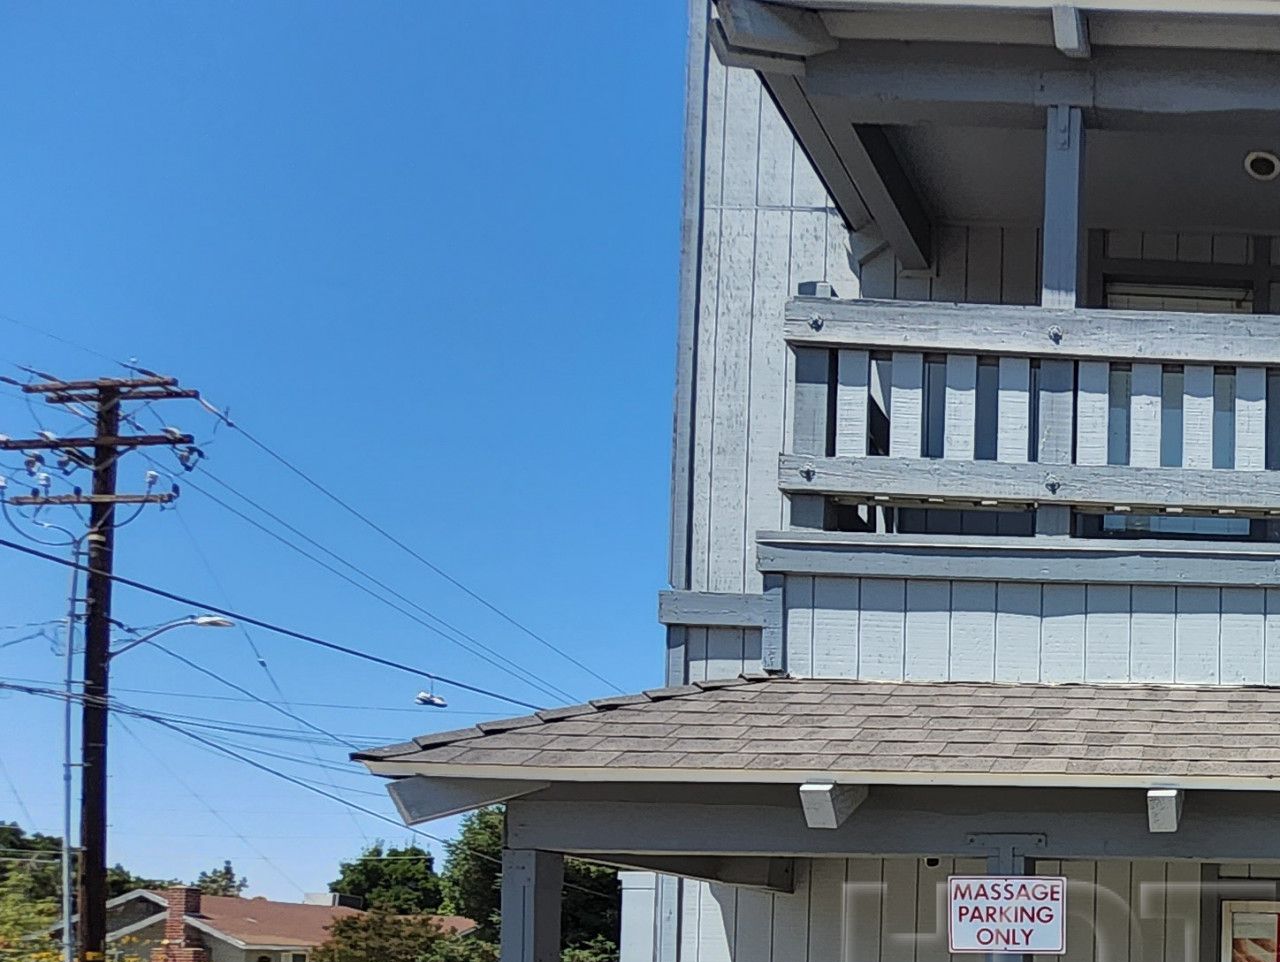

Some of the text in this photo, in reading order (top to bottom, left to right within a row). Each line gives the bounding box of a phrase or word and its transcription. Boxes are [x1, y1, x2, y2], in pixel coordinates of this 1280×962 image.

[953, 884, 1060, 901] MASSAGE
[958, 906, 1054, 923] PARKING
[976, 928, 1034, 946] ONLY
